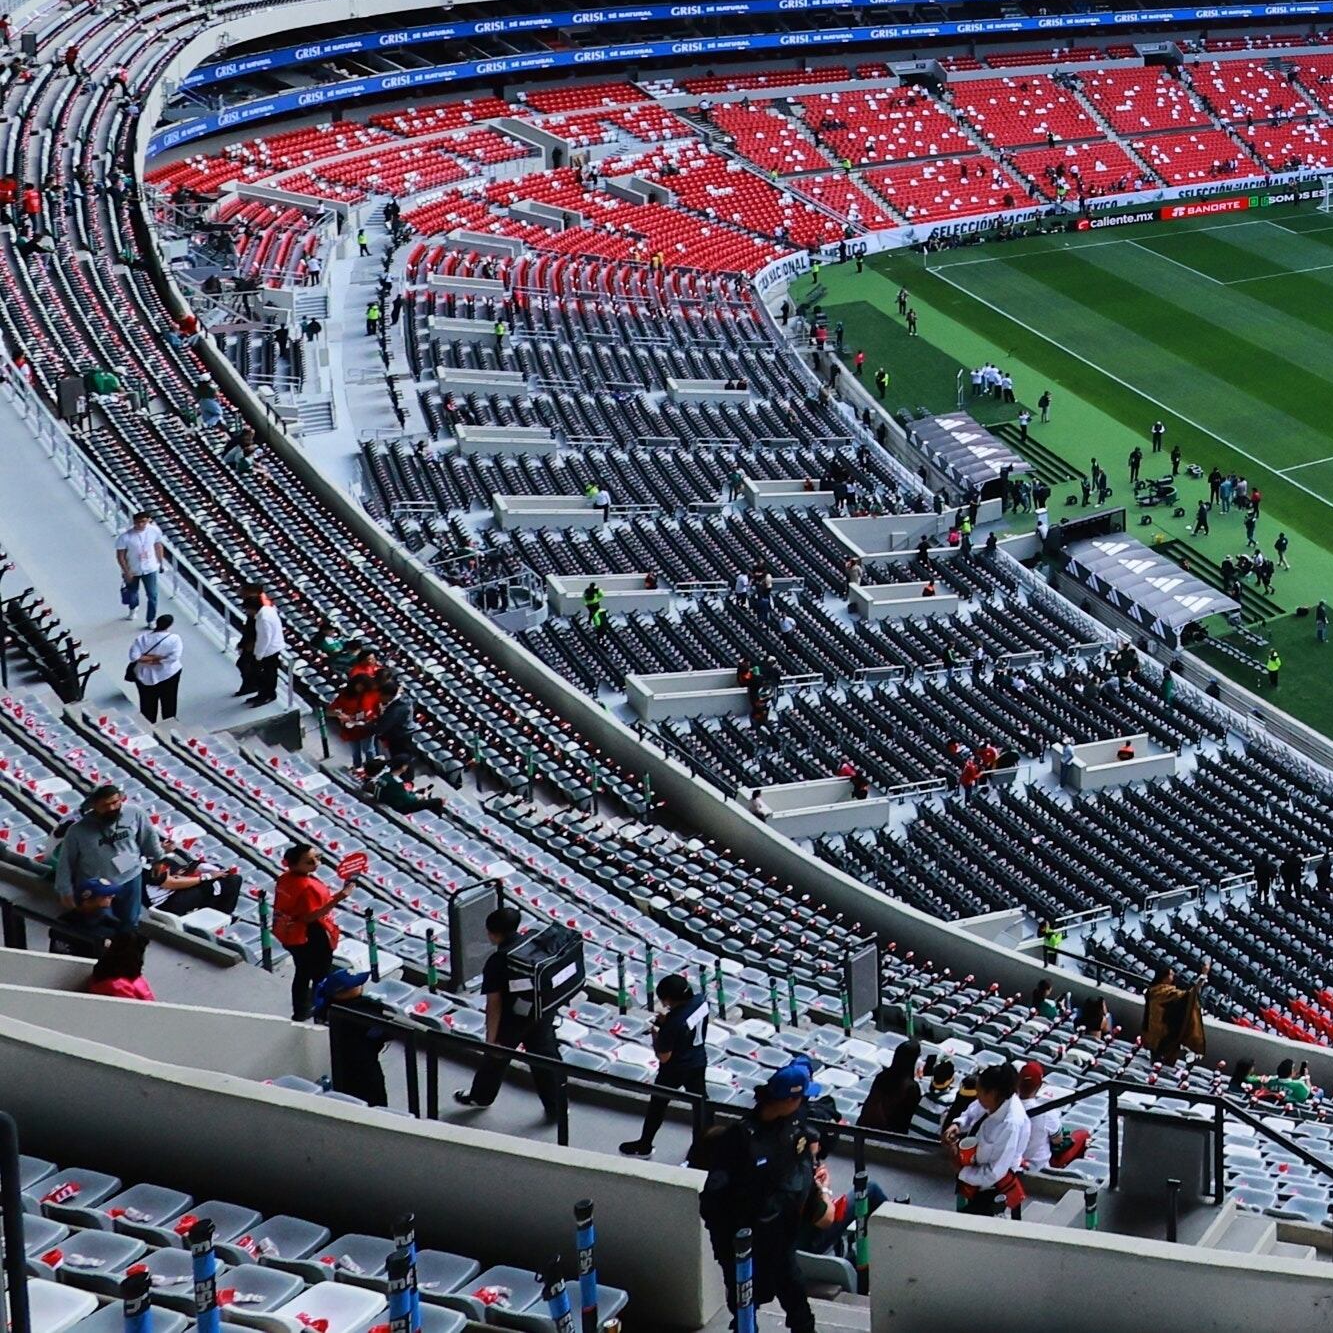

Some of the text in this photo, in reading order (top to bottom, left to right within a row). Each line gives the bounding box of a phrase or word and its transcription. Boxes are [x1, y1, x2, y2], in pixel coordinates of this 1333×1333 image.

[670, 5, 701, 16] GRISI
[1195, 9, 1219, 18] GRISI
[572, 12, 604, 23] GRISI
[1038, 18, 1063, 28] GRISI
[1114, 13, 1138, 23] GRISI
[474, 21, 504, 33] GRISI
[957, 23, 983, 33] GRISI
[379, 32, 408, 46] GRISI
[870, 28, 898, 39] GRISI
[780, 34, 809, 45] GRISI
[295, 45, 321, 60] GRISI
[672, 42, 703, 53] GRISI
[574, 50, 605, 62] GRISI
[476, 61, 506, 74] GRISI
[381, 75, 411, 89] GRISI
[298, 90, 324, 105] GRISI
[1188, 201, 1241, 214] BANORTE
[1090, 213, 1154, 229] caliente.mx
